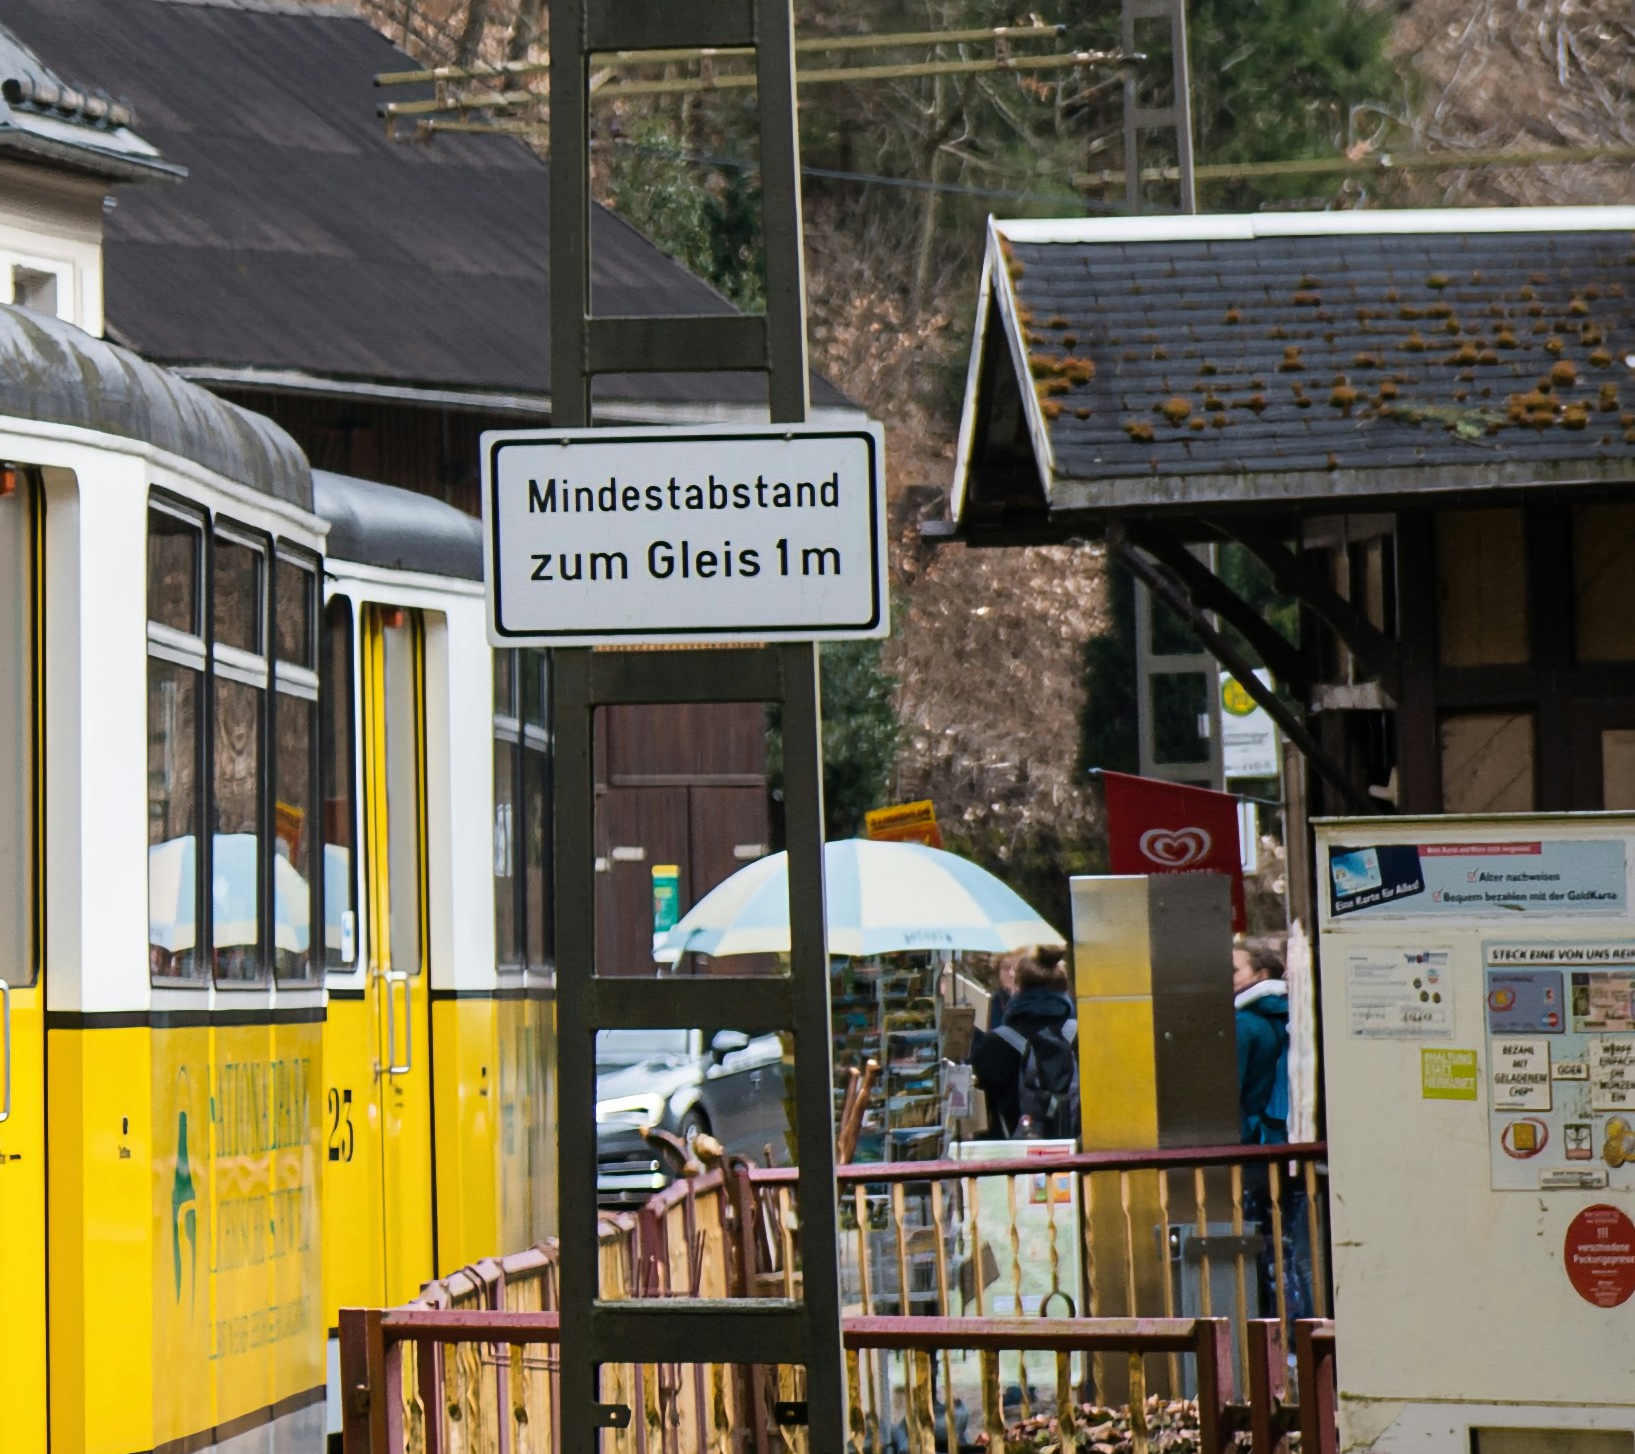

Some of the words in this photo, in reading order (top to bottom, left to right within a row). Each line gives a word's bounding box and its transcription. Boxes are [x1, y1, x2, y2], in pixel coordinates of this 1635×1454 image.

[528, 472, 839, 513] Mindestabstand
[530, 551, 629, 581] zum
[648, 540, 762, 578] Gleis
[1479, 872, 1504, 882] Alter
[1443, 892, 1483, 904] Bequem
[1484, 891, 1528, 902] bezahlen
[1548, 890, 1565, 901] der
[1492, 949, 1528, 960] STECK
[1529, 949, 1556, 960] EINE
[1558, 948, 1584, 960] VON
[1586, 949, 1610, 960] UNS
